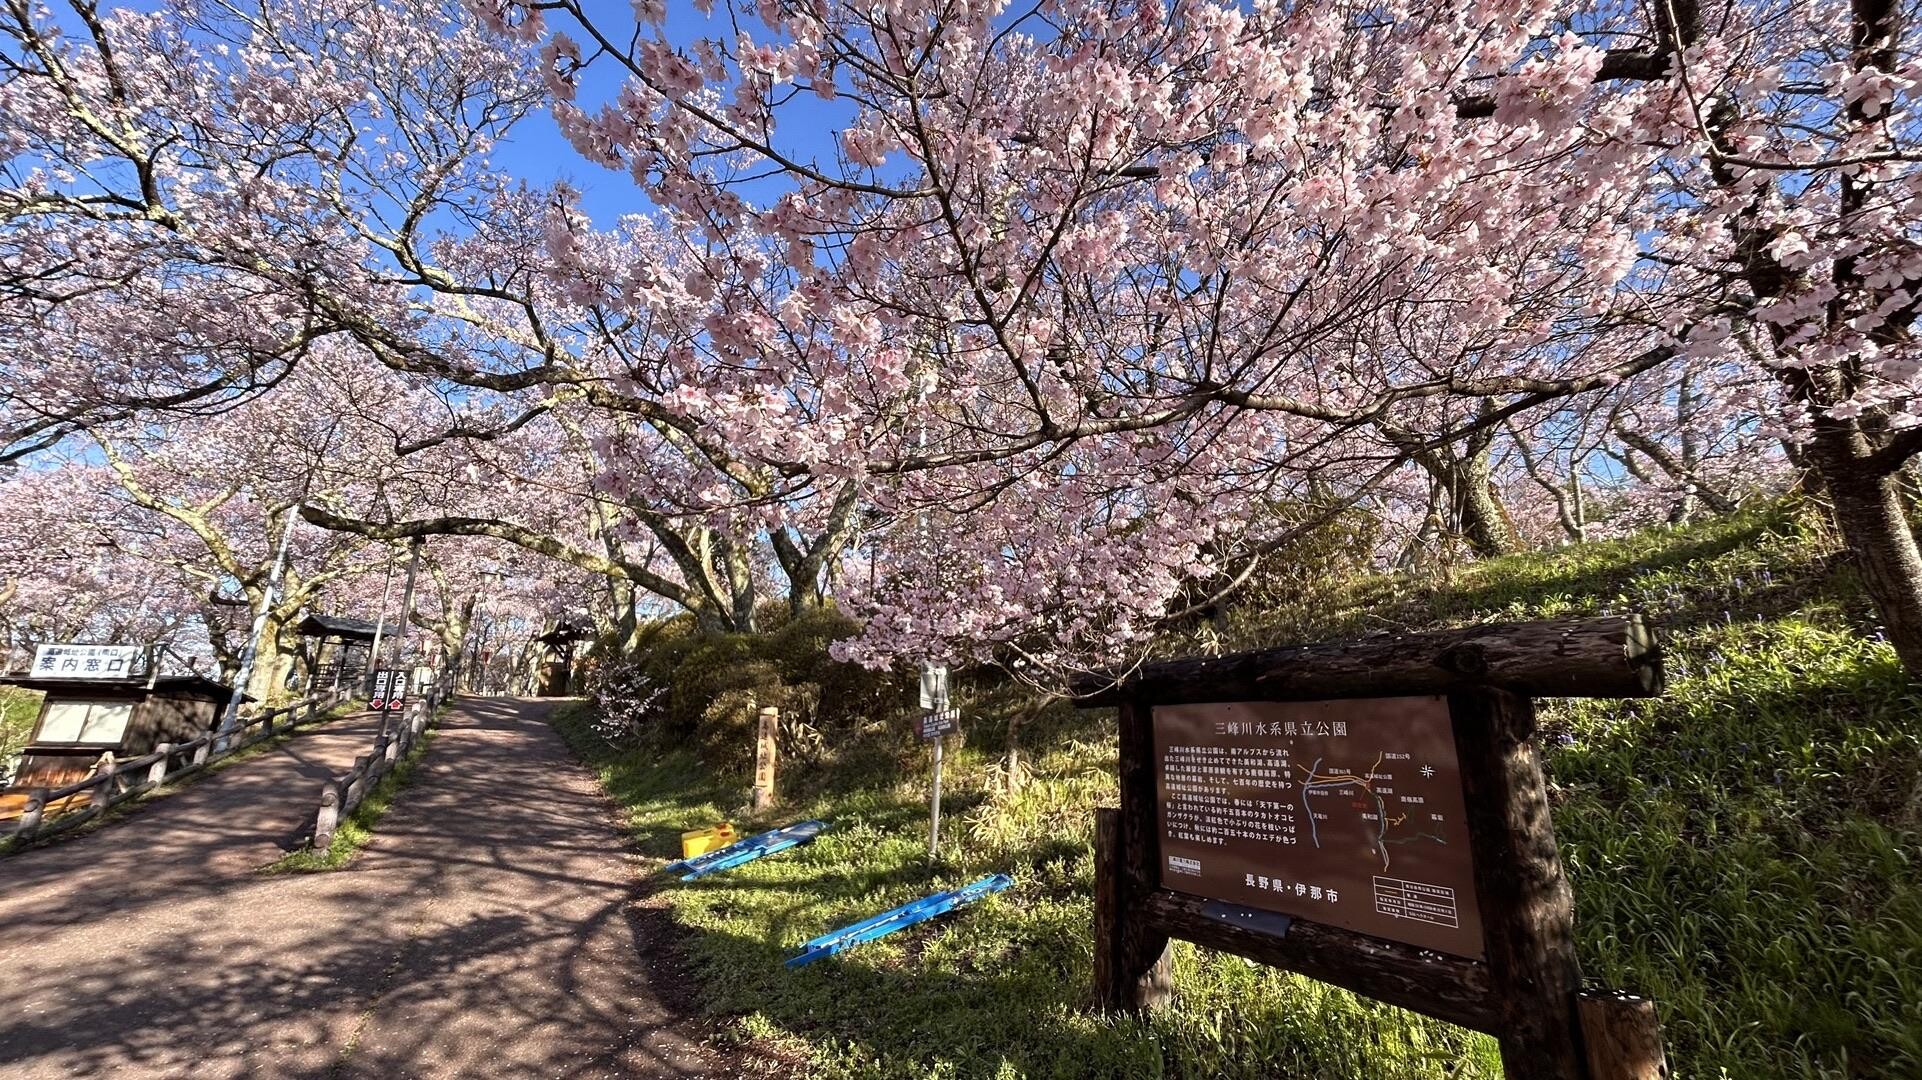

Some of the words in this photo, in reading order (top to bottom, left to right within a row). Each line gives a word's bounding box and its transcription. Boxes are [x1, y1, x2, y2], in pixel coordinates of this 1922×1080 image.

[39, 656, 124, 672] 案内窓口
[373, 671, 388, 699] 出口専用
[392, 671, 407, 699] 入口専用
[1215, 721, 1348, 737] 三峰川水系県立公園
[1245, 873, 1339, 904] 長野県・伊那市
